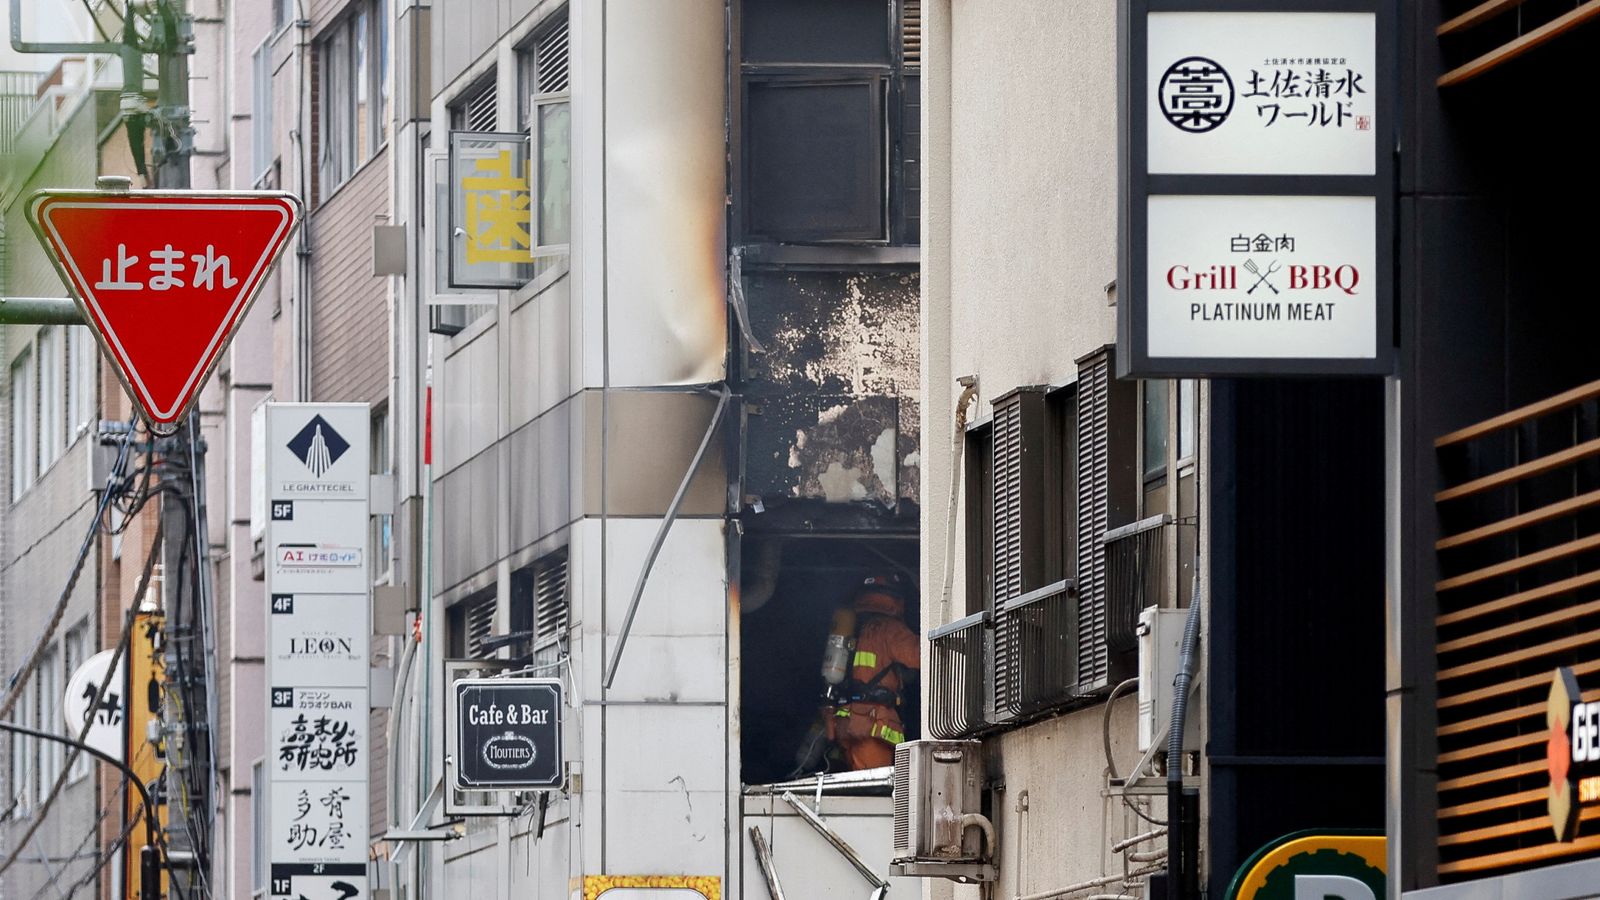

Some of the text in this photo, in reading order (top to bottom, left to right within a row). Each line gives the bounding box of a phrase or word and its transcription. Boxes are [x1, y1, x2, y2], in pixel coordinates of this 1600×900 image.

[1241, 69, 1367, 99] 土佐清水
[1256, 101, 1354, 128] ワールド
[1230, 233, 1295, 252] 白金肉
[94, 243, 239, 291] 止まれ
[1166, 264, 1361, 296] Grill BBQ
[1190, 303, 1336, 321] PLATINUM MEAT
[296, 484, 354, 492] GRATTECIEL
[273, 504, 292, 518] 5F
[283, 551, 304, 562] AI
[273, 598, 292, 611] 4F
[290, 637, 352, 655] LEON
[273, 691, 292, 705] 3F
[299, 691, 330, 700] アニソン
[299, 700, 352, 709] カラオケBAR
[469, 704, 549, 726] Cafe & Bar
[287, 713, 348, 743] 高まり
[279, 741, 358, 771] 研究所
[312, 863, 326, 874] 2F
[273, 879, 290, 893] 1F
